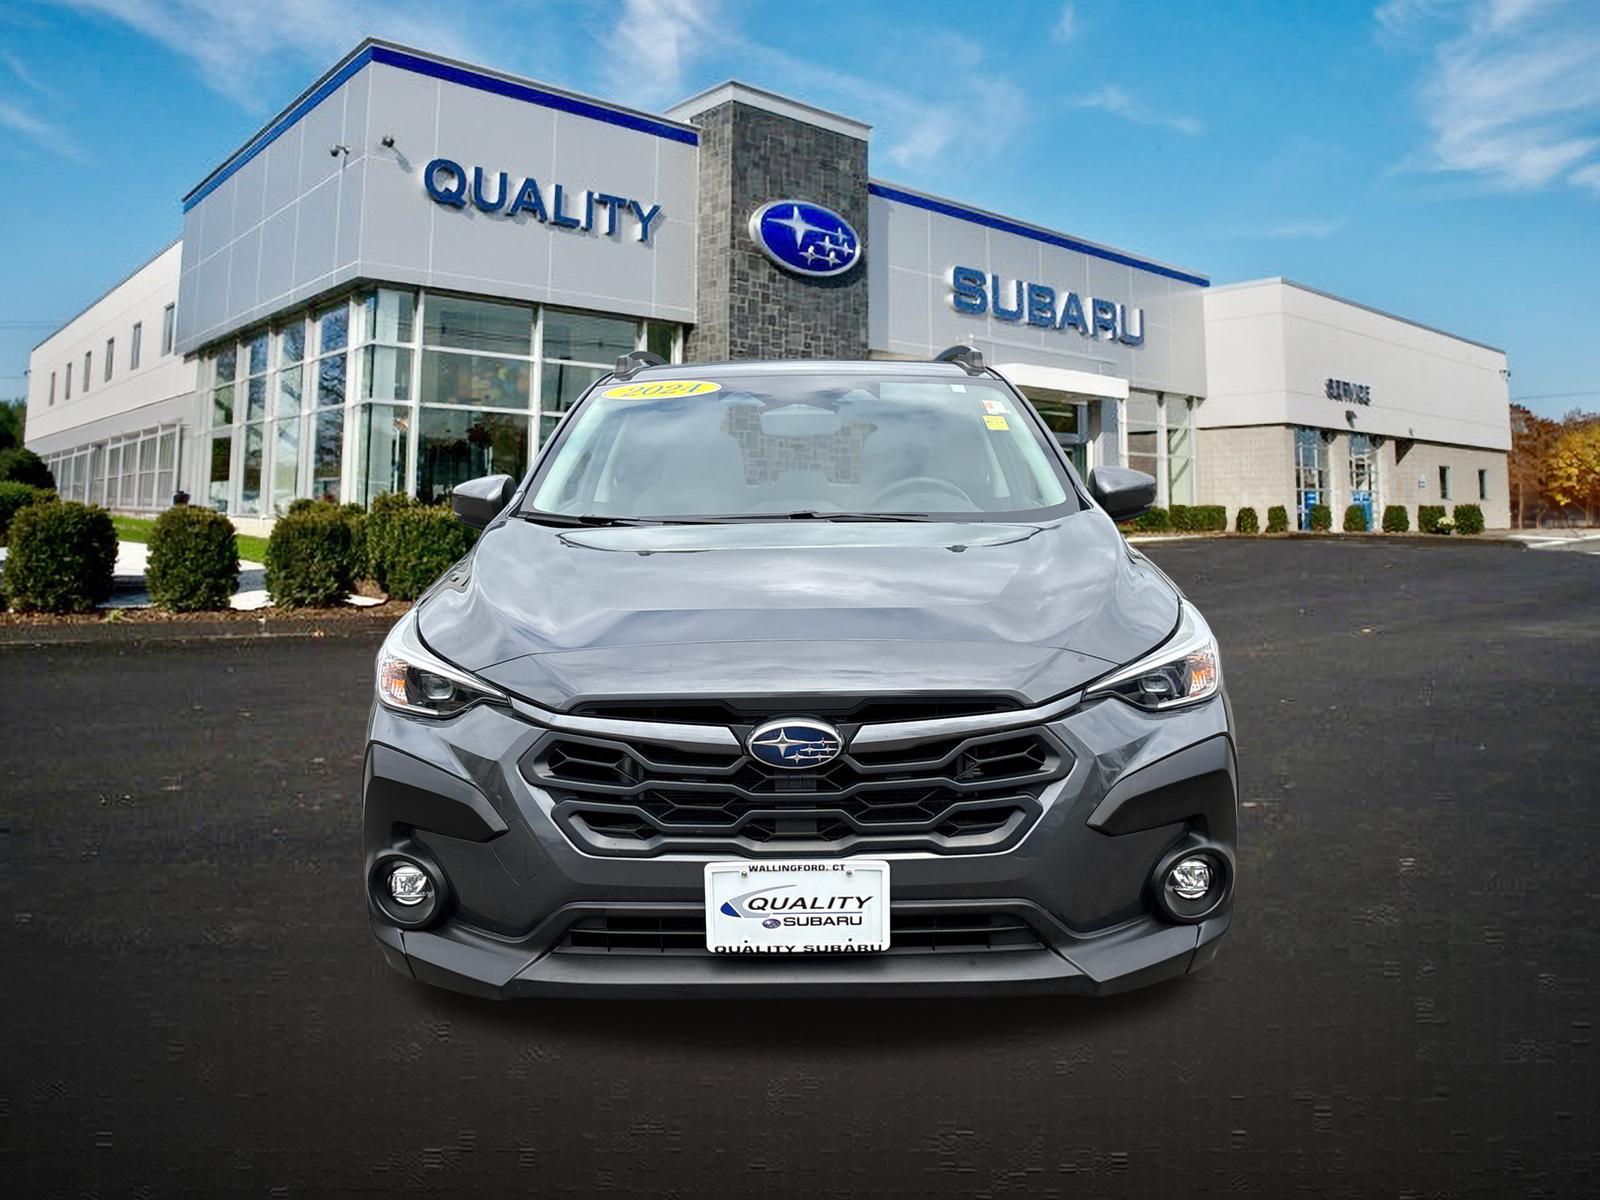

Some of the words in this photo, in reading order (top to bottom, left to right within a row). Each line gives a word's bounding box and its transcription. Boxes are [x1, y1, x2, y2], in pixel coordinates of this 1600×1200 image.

[423, 158, 661, 243] QUALITY
[951, 266, 1145, 346] SUBARU
[622, 383, 702, 397] 2024
[747, 896, 873, 911] QUALITY
[783, 916, 863, 927] SUBARU
[714, 945, 796, 953] QUALITY
[803, 944, 882, 953] SUBARU
